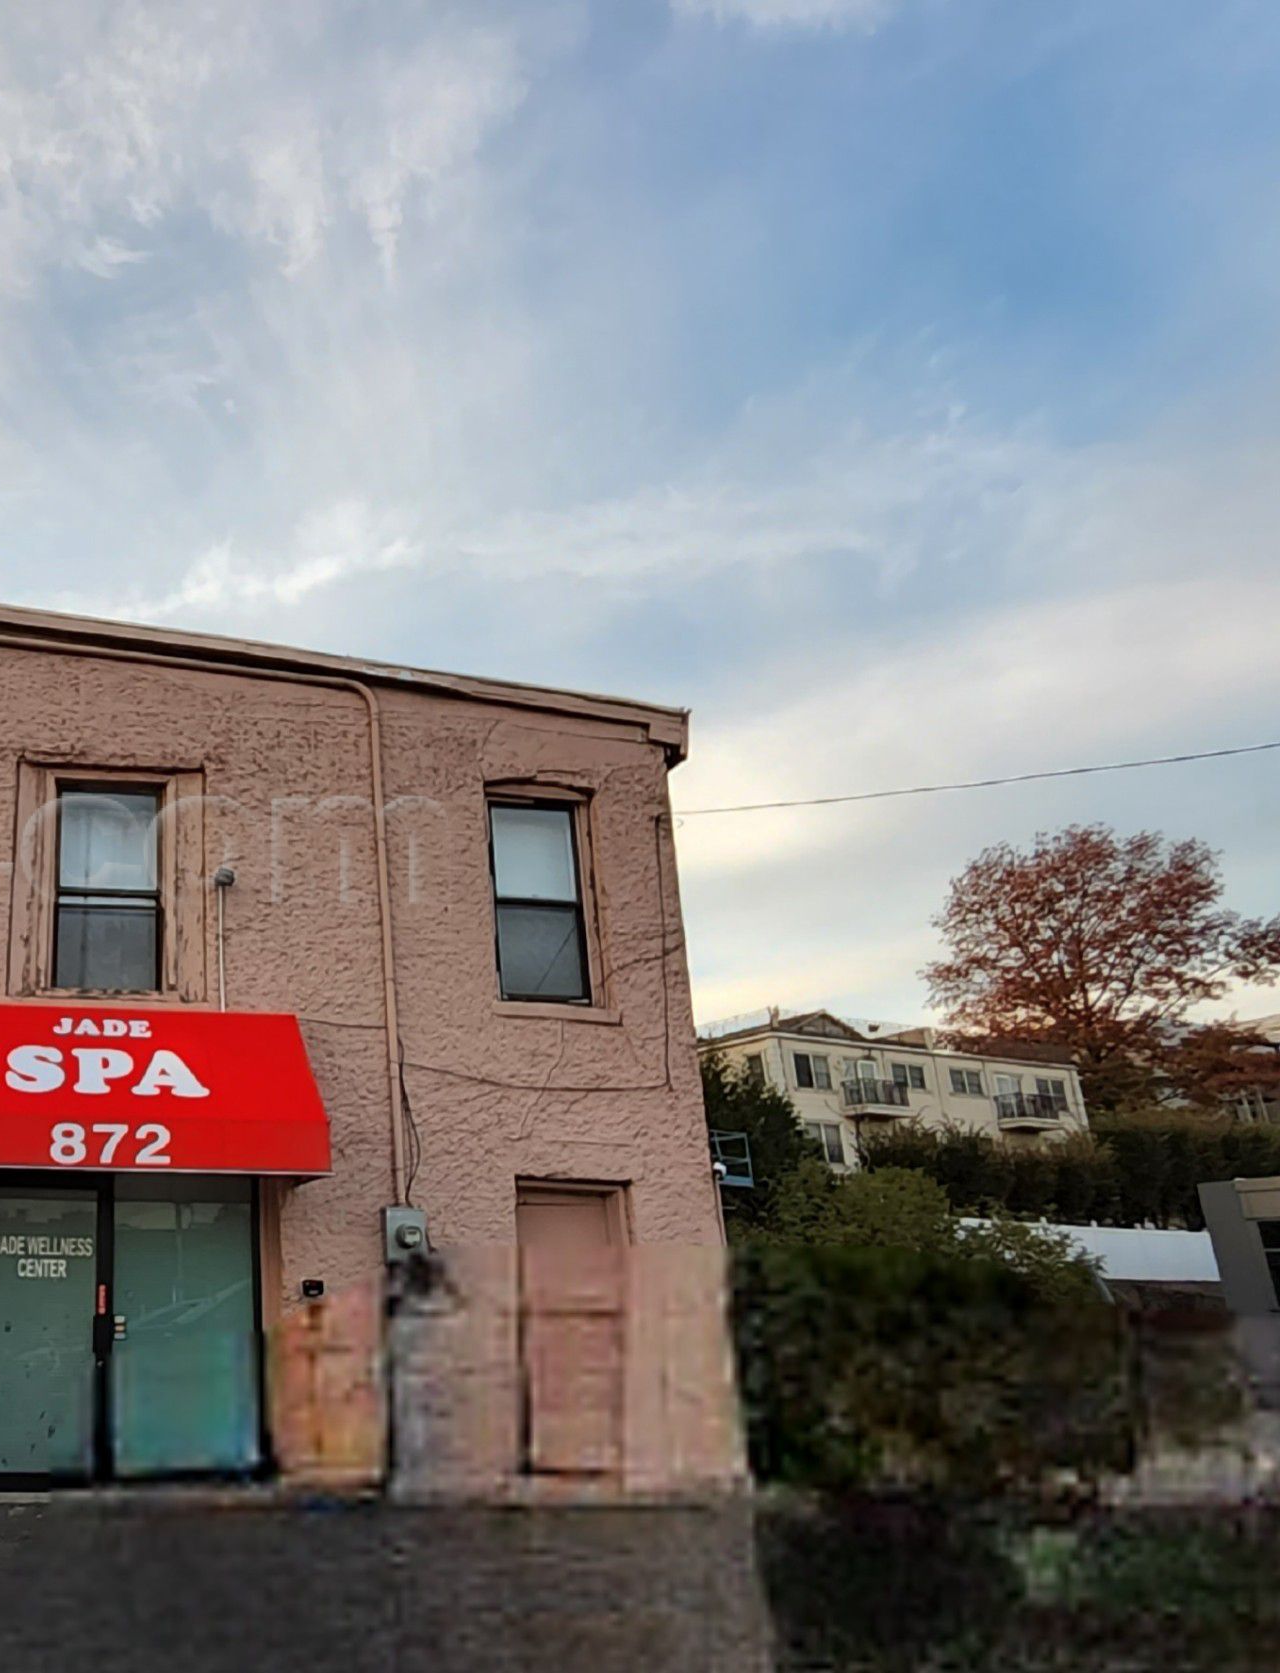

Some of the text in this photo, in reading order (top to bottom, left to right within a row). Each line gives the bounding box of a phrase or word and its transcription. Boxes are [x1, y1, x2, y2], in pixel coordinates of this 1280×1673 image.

[53, 1017, 152, 1038] JADE
[5, 1045, 210, 1098] SPA
[49, 1123, 172, 1164] 872
[26, 1236, 93, 1257] WELLNESS
[17, 1258, 67, 1278] CENTER
